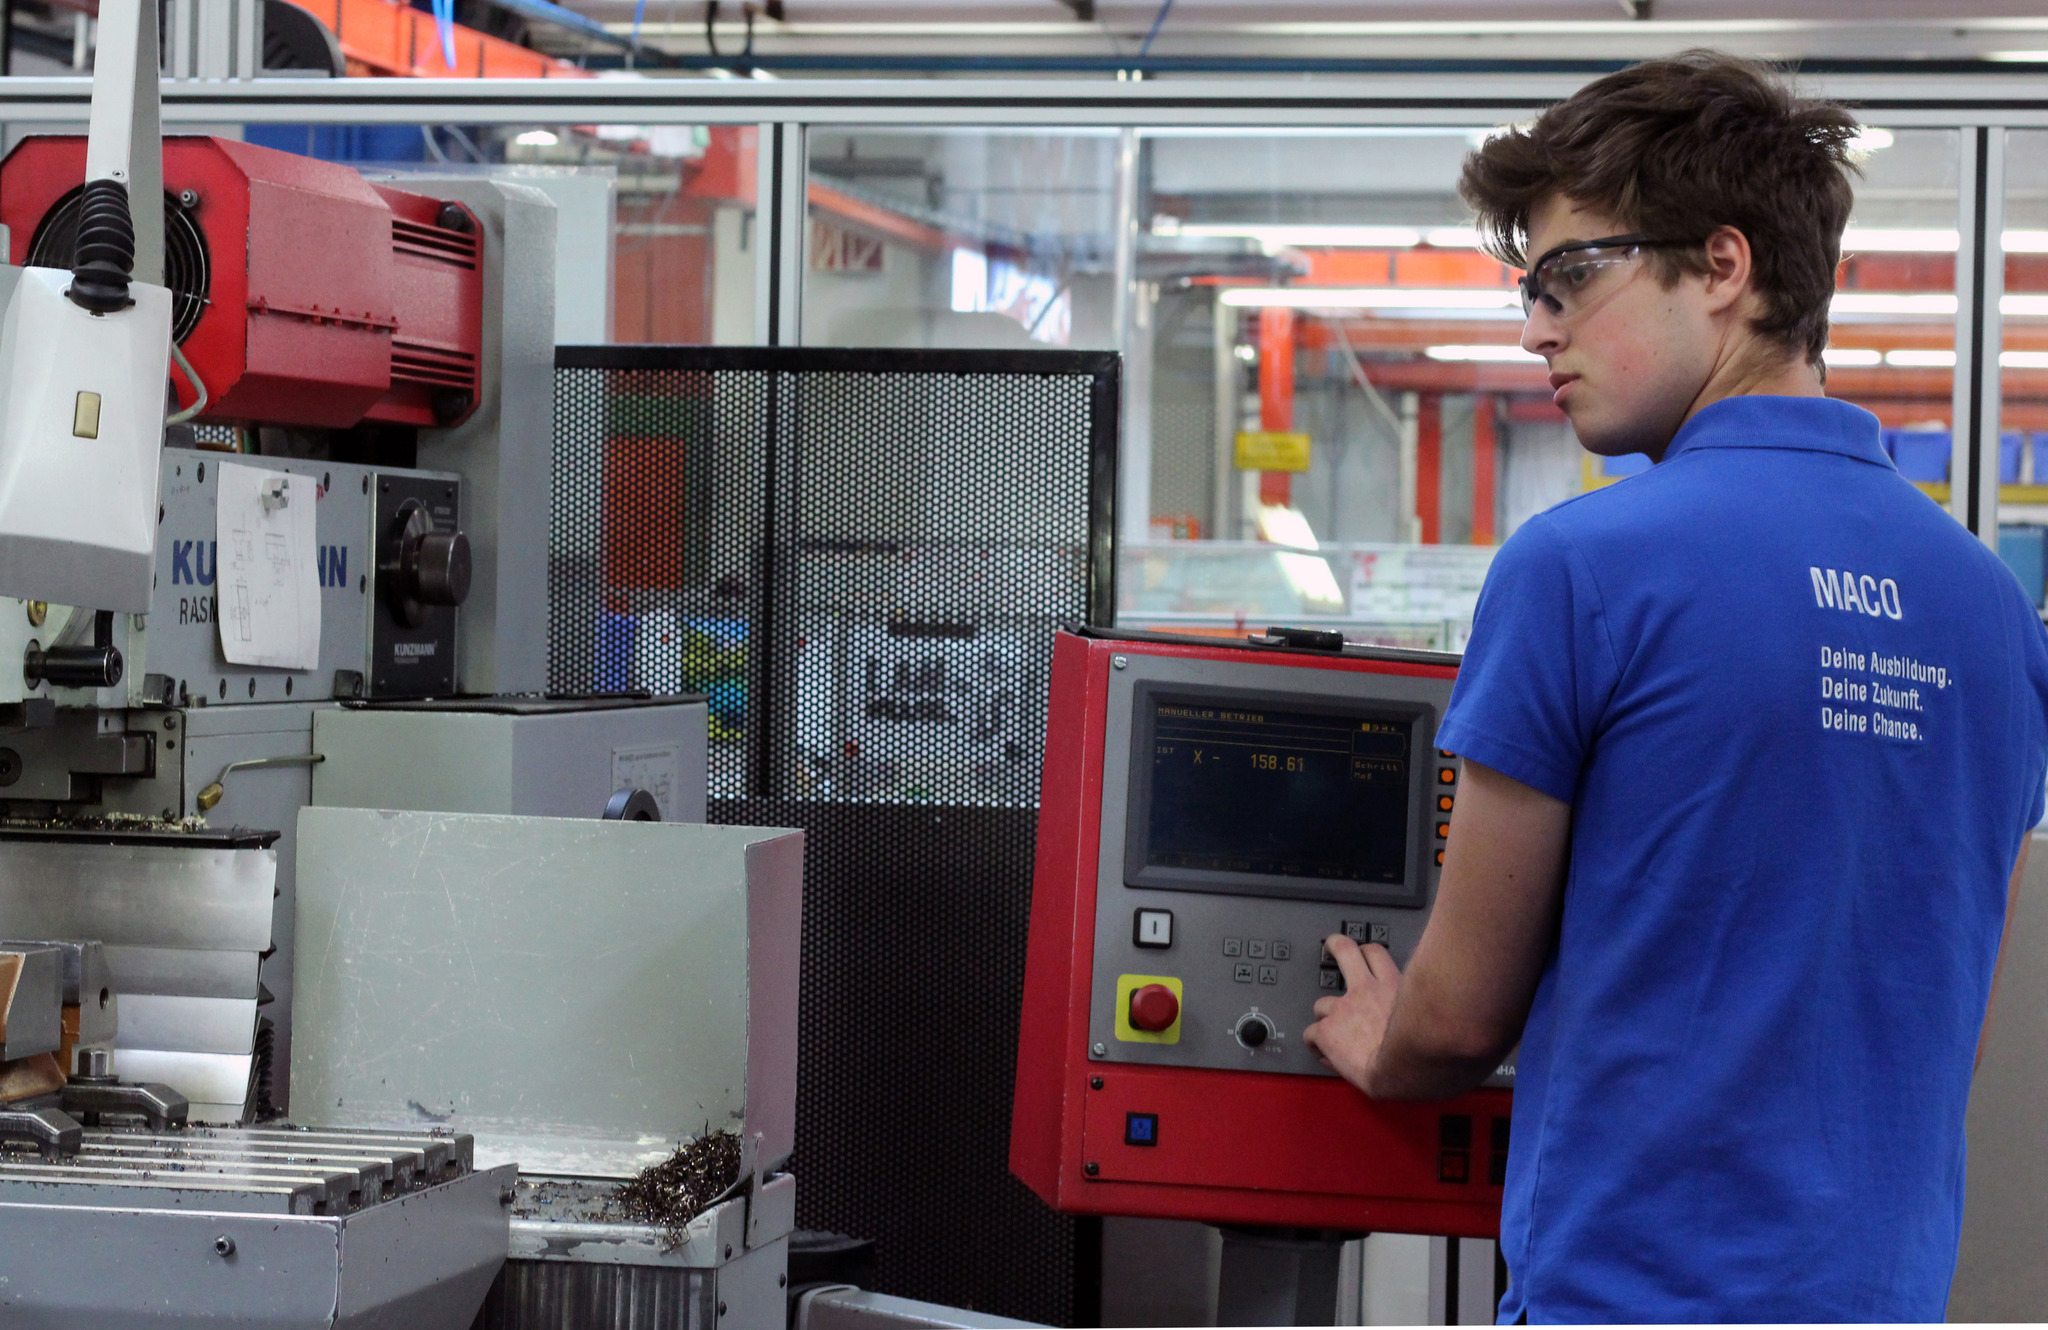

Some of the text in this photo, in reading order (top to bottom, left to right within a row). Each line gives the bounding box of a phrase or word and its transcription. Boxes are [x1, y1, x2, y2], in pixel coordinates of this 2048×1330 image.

[1809, 566, 1903, 621] MACO
[1821, 646, 1953, 689] Deine Ausbildung.
[1822, 676, 1924, 711] Deine Zukunft.
[1157, 707, 1264, 722] MANUELLER BETRIEB
[1821, 707, 1923, 741] Deine Chance.
[1193, 749, 1203, 765] X
[1250, 753, 1305, 773] 158.61
